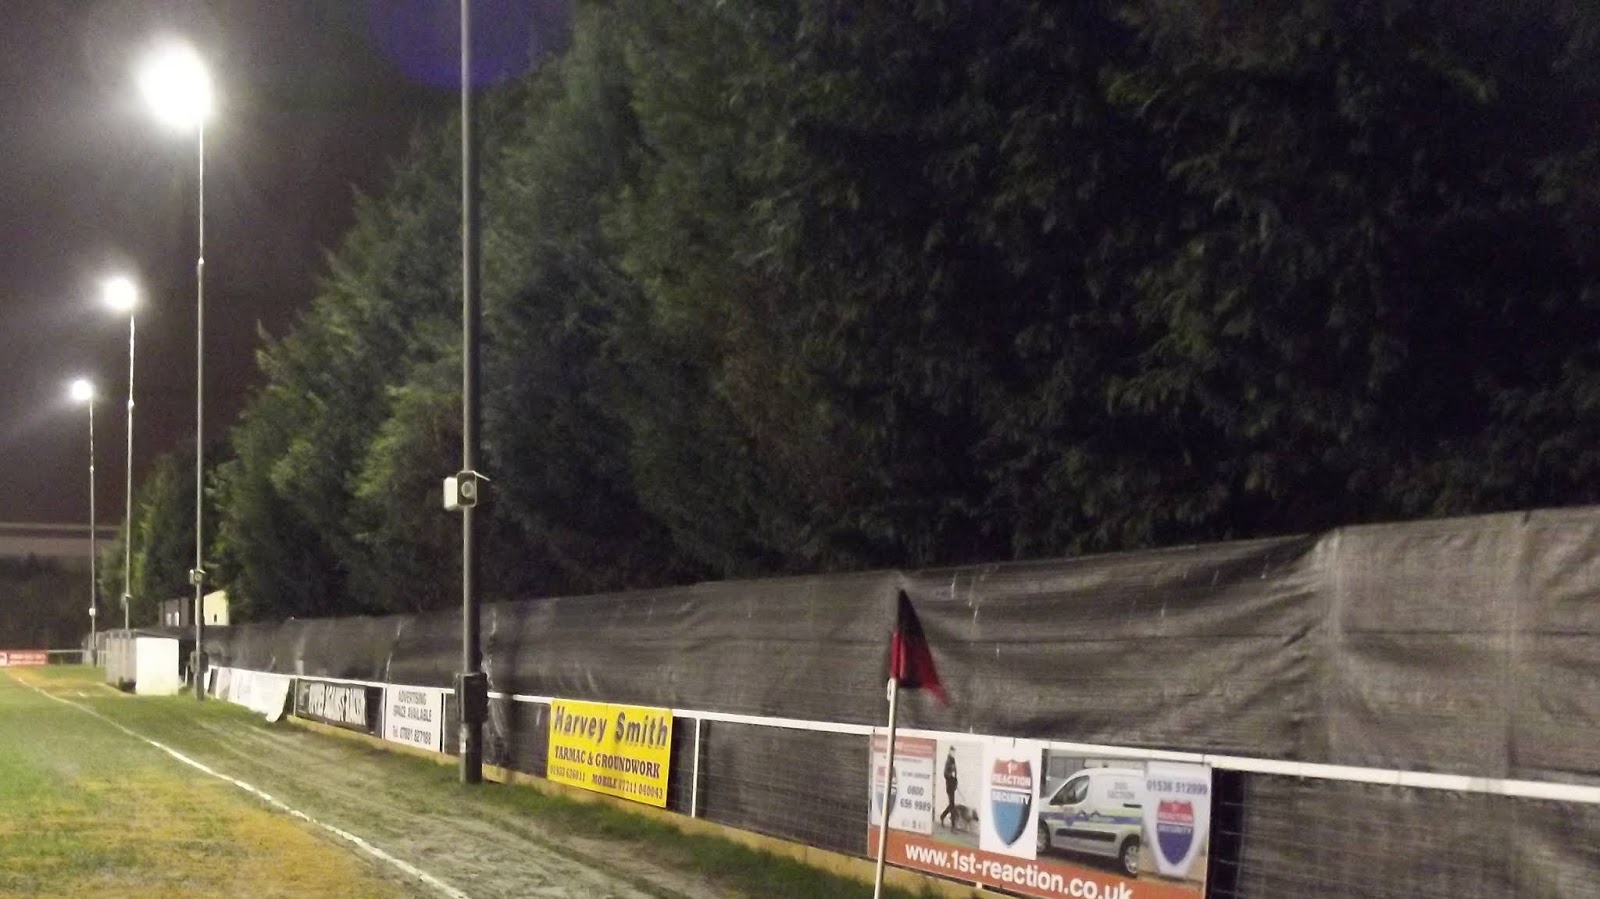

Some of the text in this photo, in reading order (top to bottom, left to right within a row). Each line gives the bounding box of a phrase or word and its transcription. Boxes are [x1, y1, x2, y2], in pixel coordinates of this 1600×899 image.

[407, 706, 432, 722] AVAILABLE
[554, 705, 668, 748] Harvey Smith
[555, 745, 661, 779] TARMAC & GROUNDWORK
[992, 773, 1032, 788] REACTION
[906, 784, 925, 797] 0800
[992, 790, 1032, 805] SECURITY
[905, 843, 1134, 899] www.1st-reaction.co.uk
